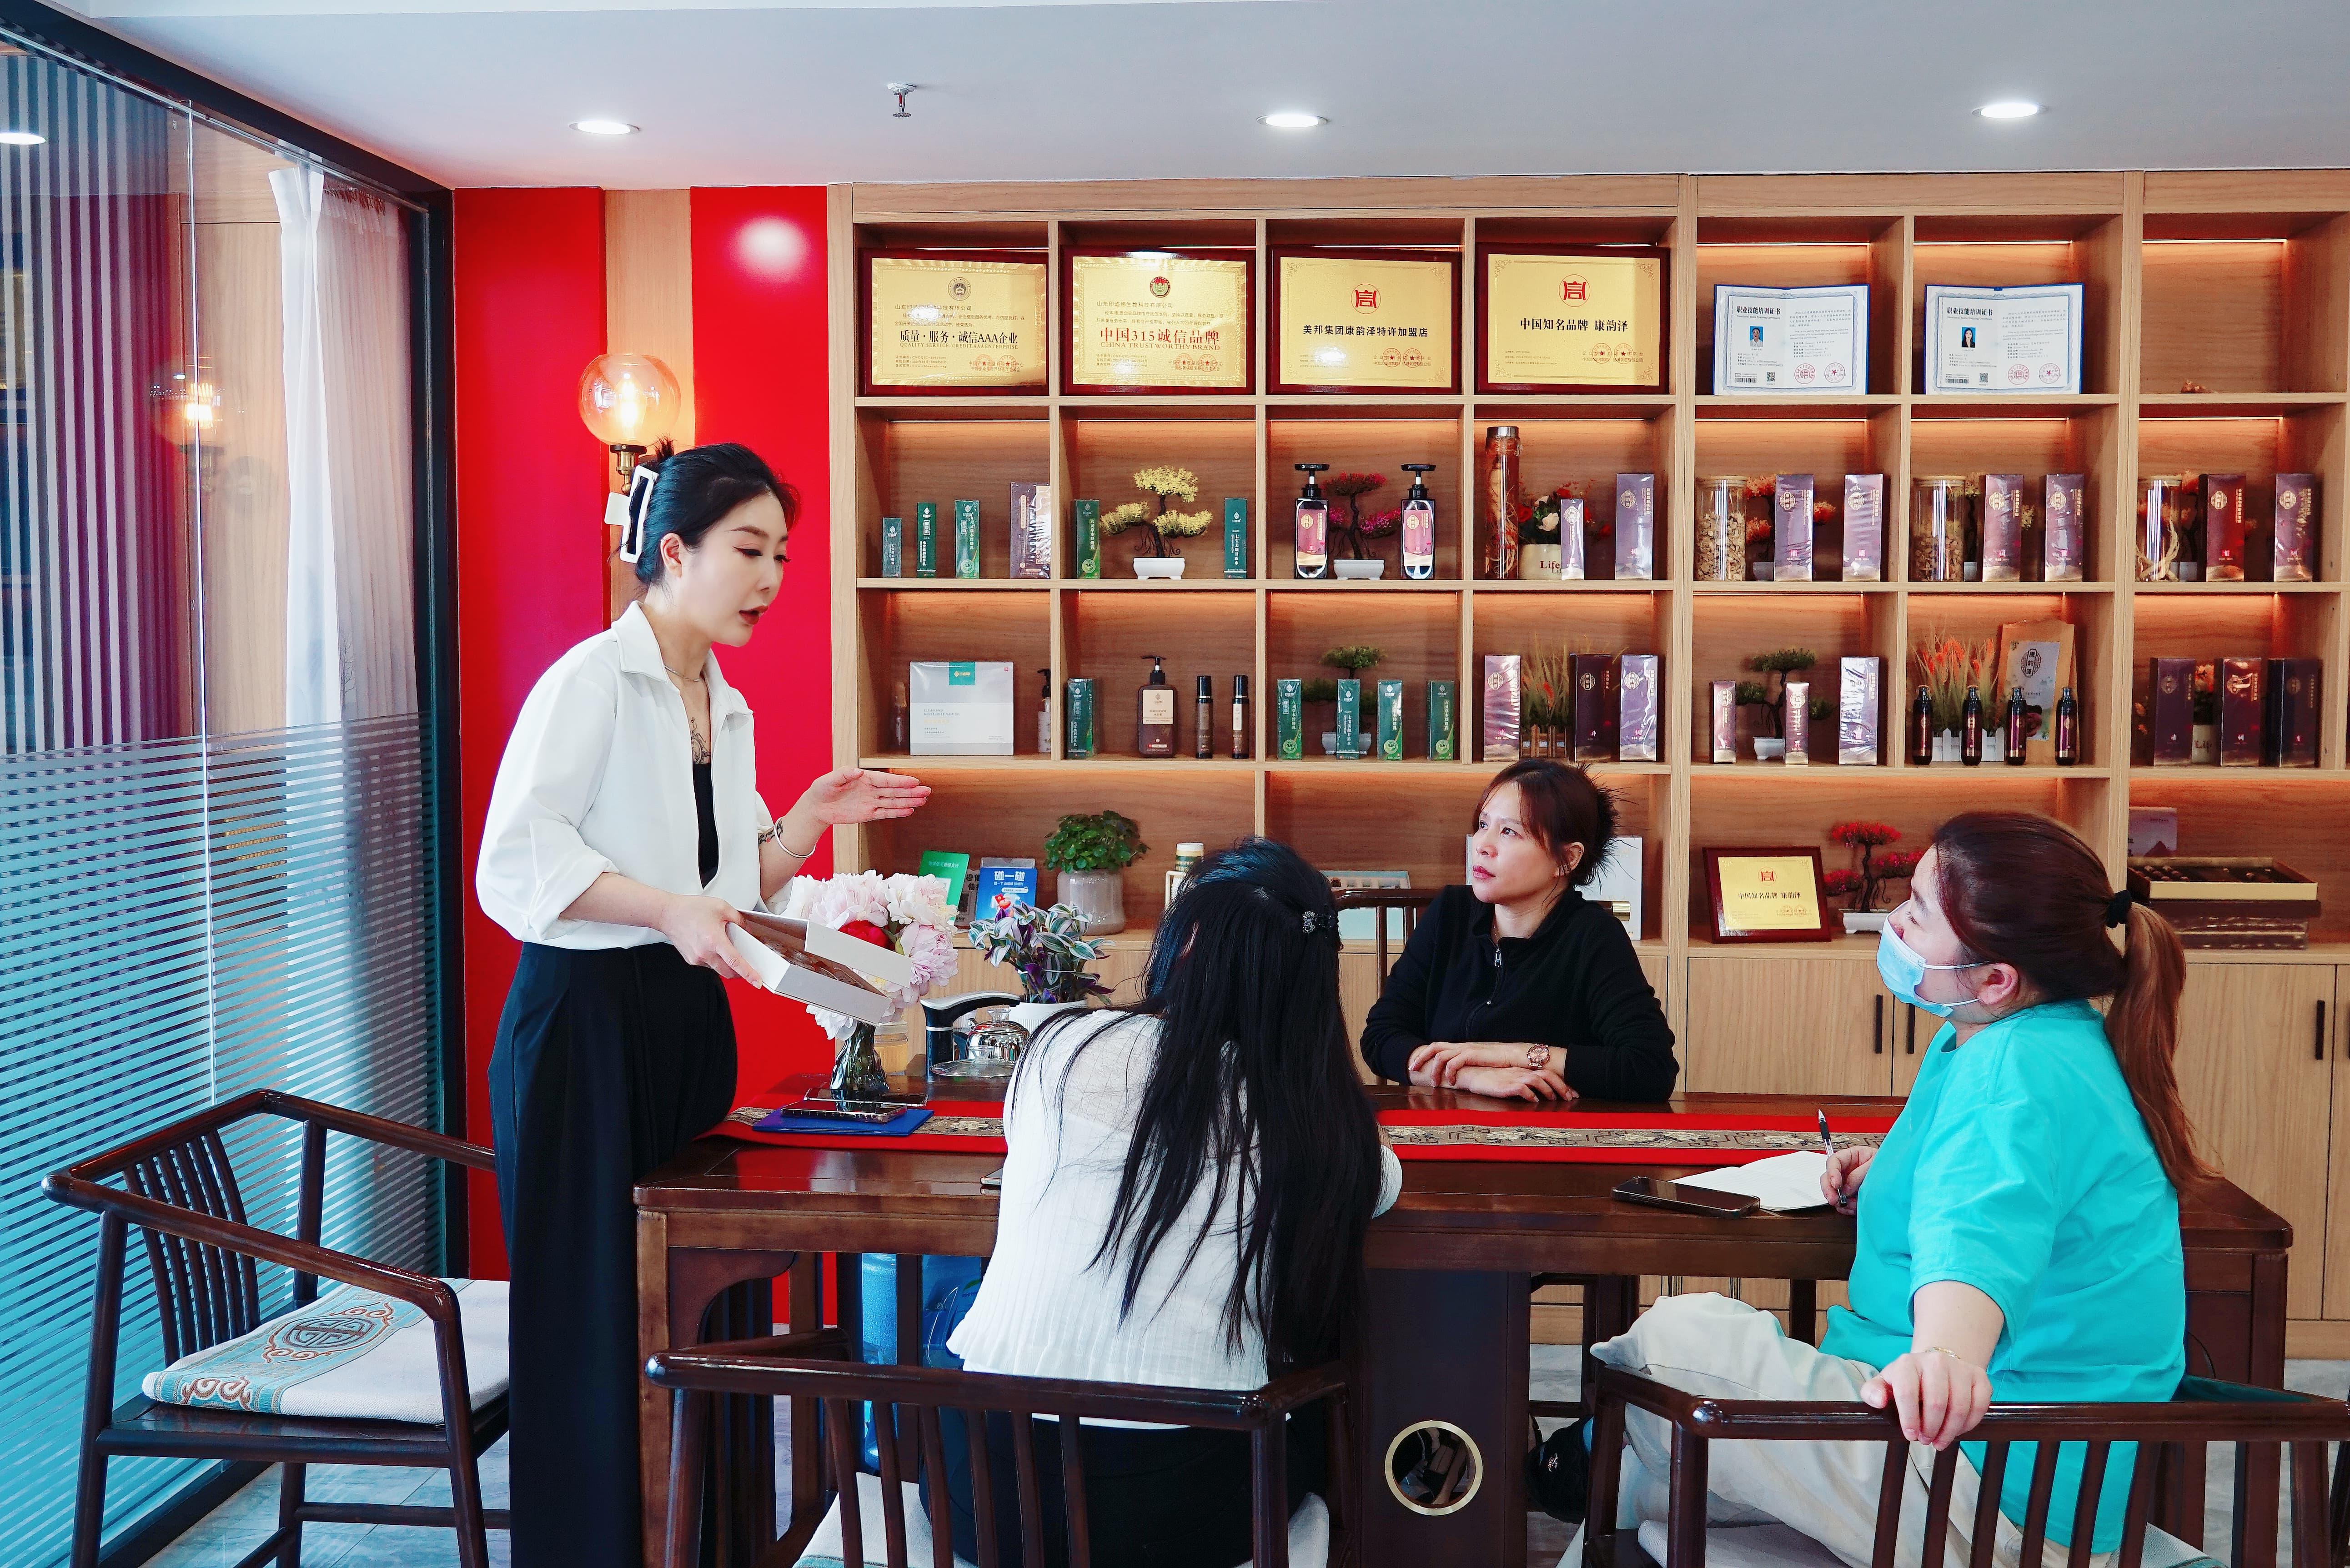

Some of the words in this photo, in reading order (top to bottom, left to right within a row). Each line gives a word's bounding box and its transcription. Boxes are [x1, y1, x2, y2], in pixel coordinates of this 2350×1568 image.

[1737, 306, 1780, 315] 职业技能培训证书
[1947, 307, 1993, 316] 职业技能培训证书
[1520, 318, 1588, 331] 中国知名品牌
[1595, 319, 1628, 332] 康韵泽
[1100, 327, 1220, 345] 中国315诚信品牌
[1303, 325, 1428, 337] 美邦集团康韵泽特许加盟店
[1540, 560, 1560, 569] Life
[994, 870, 1025, 881] 碰一碰
